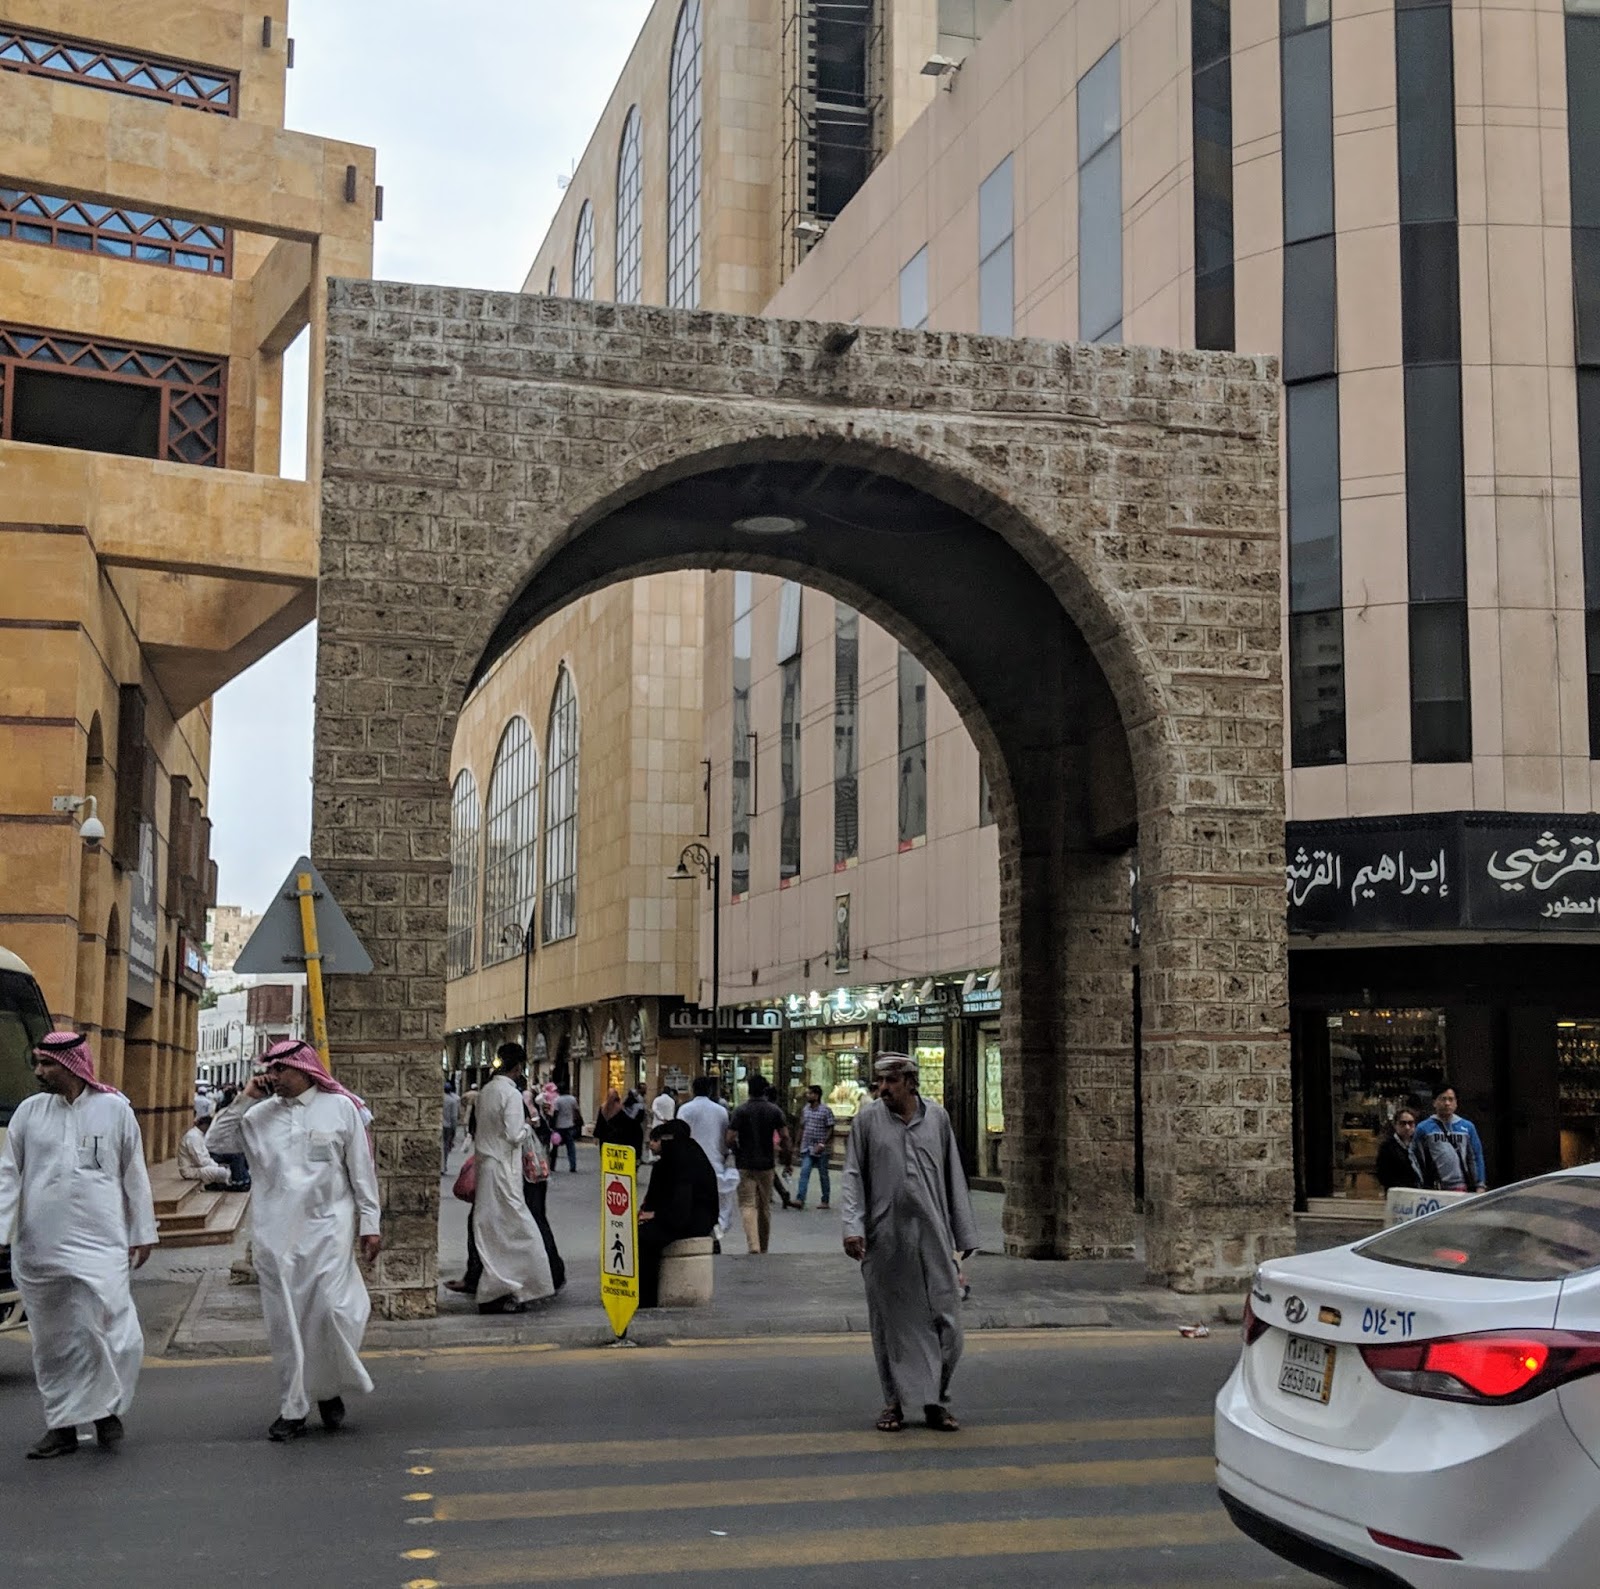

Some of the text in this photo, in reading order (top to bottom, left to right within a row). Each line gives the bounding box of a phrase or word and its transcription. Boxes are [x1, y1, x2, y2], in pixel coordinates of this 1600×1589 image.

[1285, 846, 1448, 907] إبراهيم القرش
[606, 1147, 628, 1160] STATE
[608, 1160, 625, 1172] LAW
[606, 1190, 628, 1207] STOP
[610, 1220, 624, 1229] FOR
[608, 1277, 629, 1288] WITHIN
[602, 1285, 636, 1298] CROSSWALK
